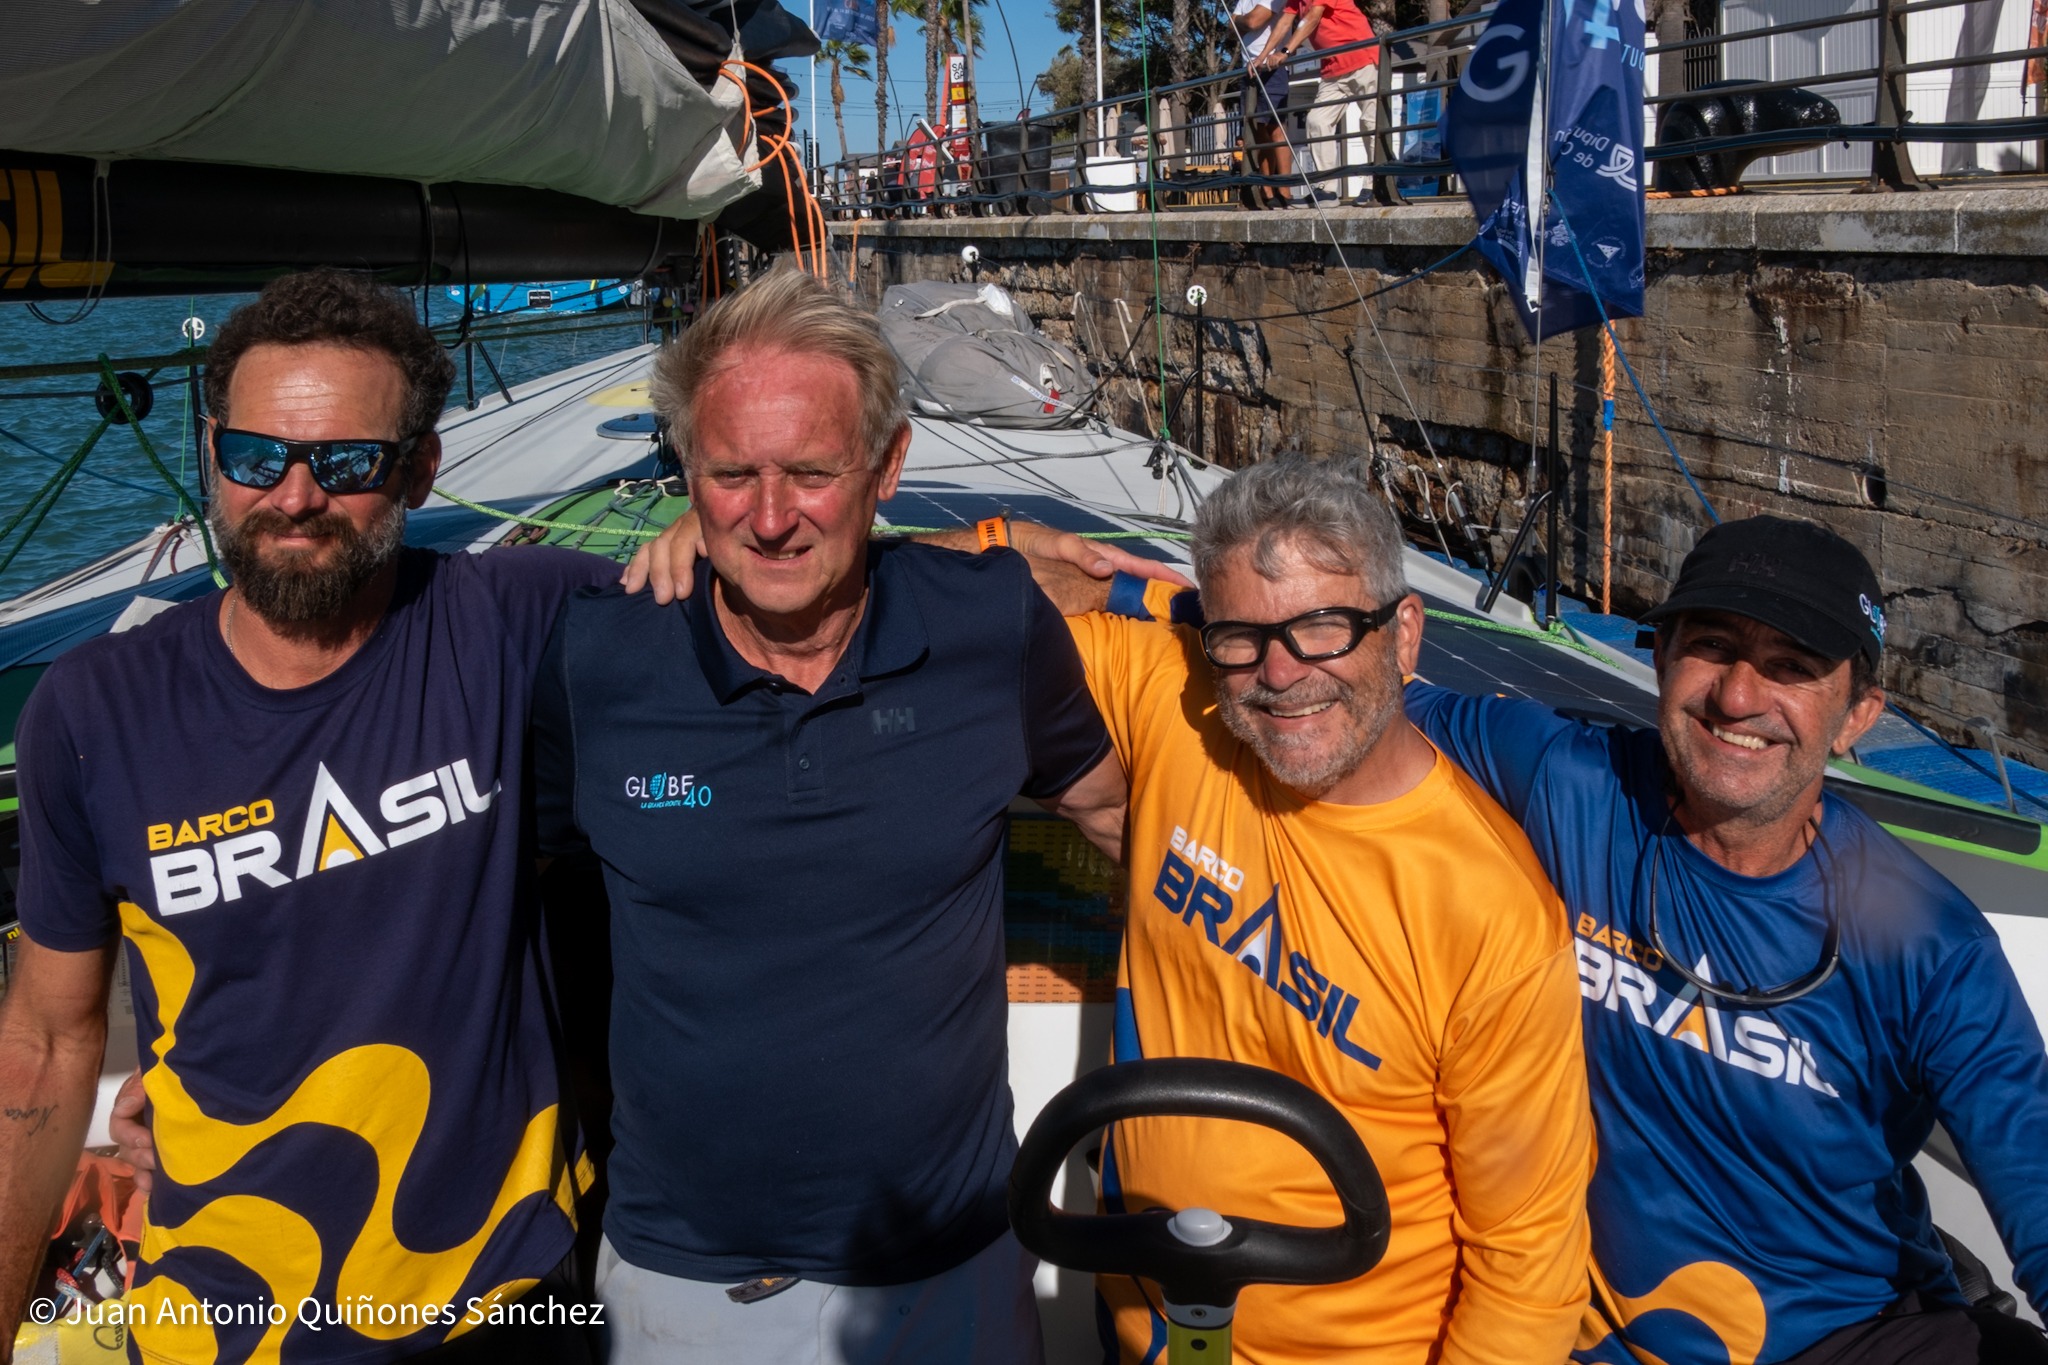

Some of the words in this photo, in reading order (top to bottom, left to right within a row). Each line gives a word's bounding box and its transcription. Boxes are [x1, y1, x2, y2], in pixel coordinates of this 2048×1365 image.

[147, 798, 275, 852] BARCO
[682, 785, 712, 808] 40
[149, 757, 503, 917] BRASIL
[1169, 824, 1245, 893] BARCO
[1153, 849, 1383, 1072] BRASIL
[1575, 911, 1666, 972] BARCO
[1574, 937, 1840, 1098] BRASIL
